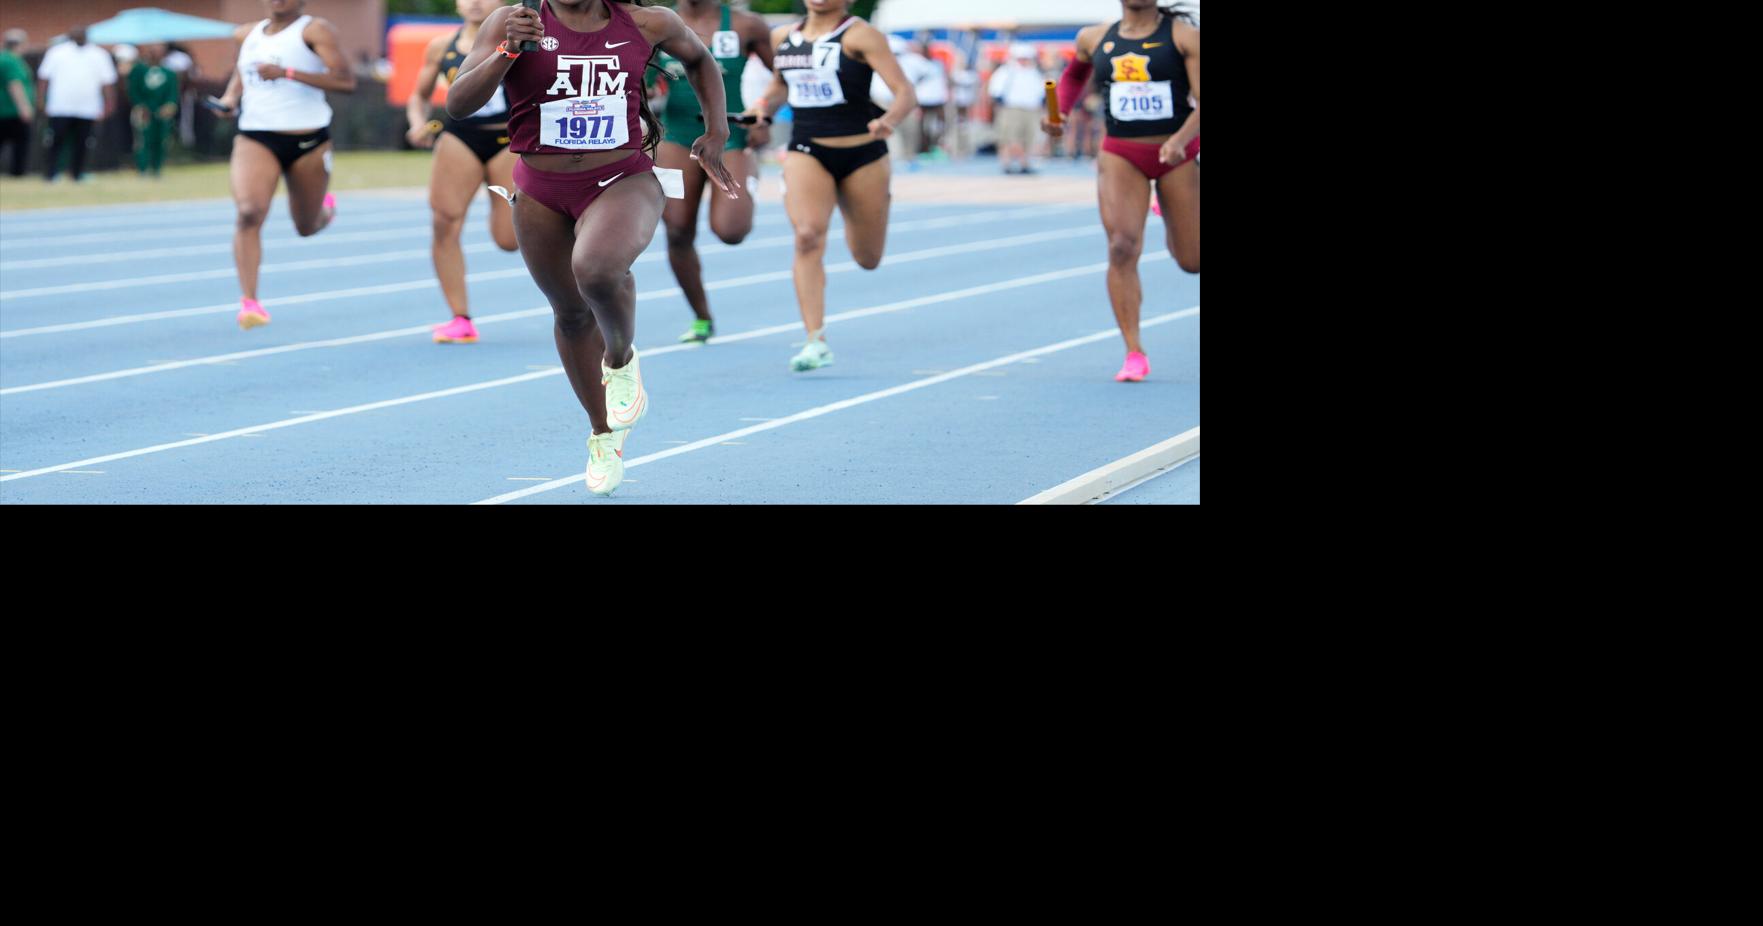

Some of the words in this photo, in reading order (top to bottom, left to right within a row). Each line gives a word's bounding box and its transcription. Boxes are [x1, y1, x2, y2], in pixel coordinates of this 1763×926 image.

[541, 37, 559, 51] SEC
[819, 46, 834, 67] 7
[1121, 59, 1140, 81] SC
[1119, 95, 1162, 111] 2105
[555, 115, 615, 139] 1977
